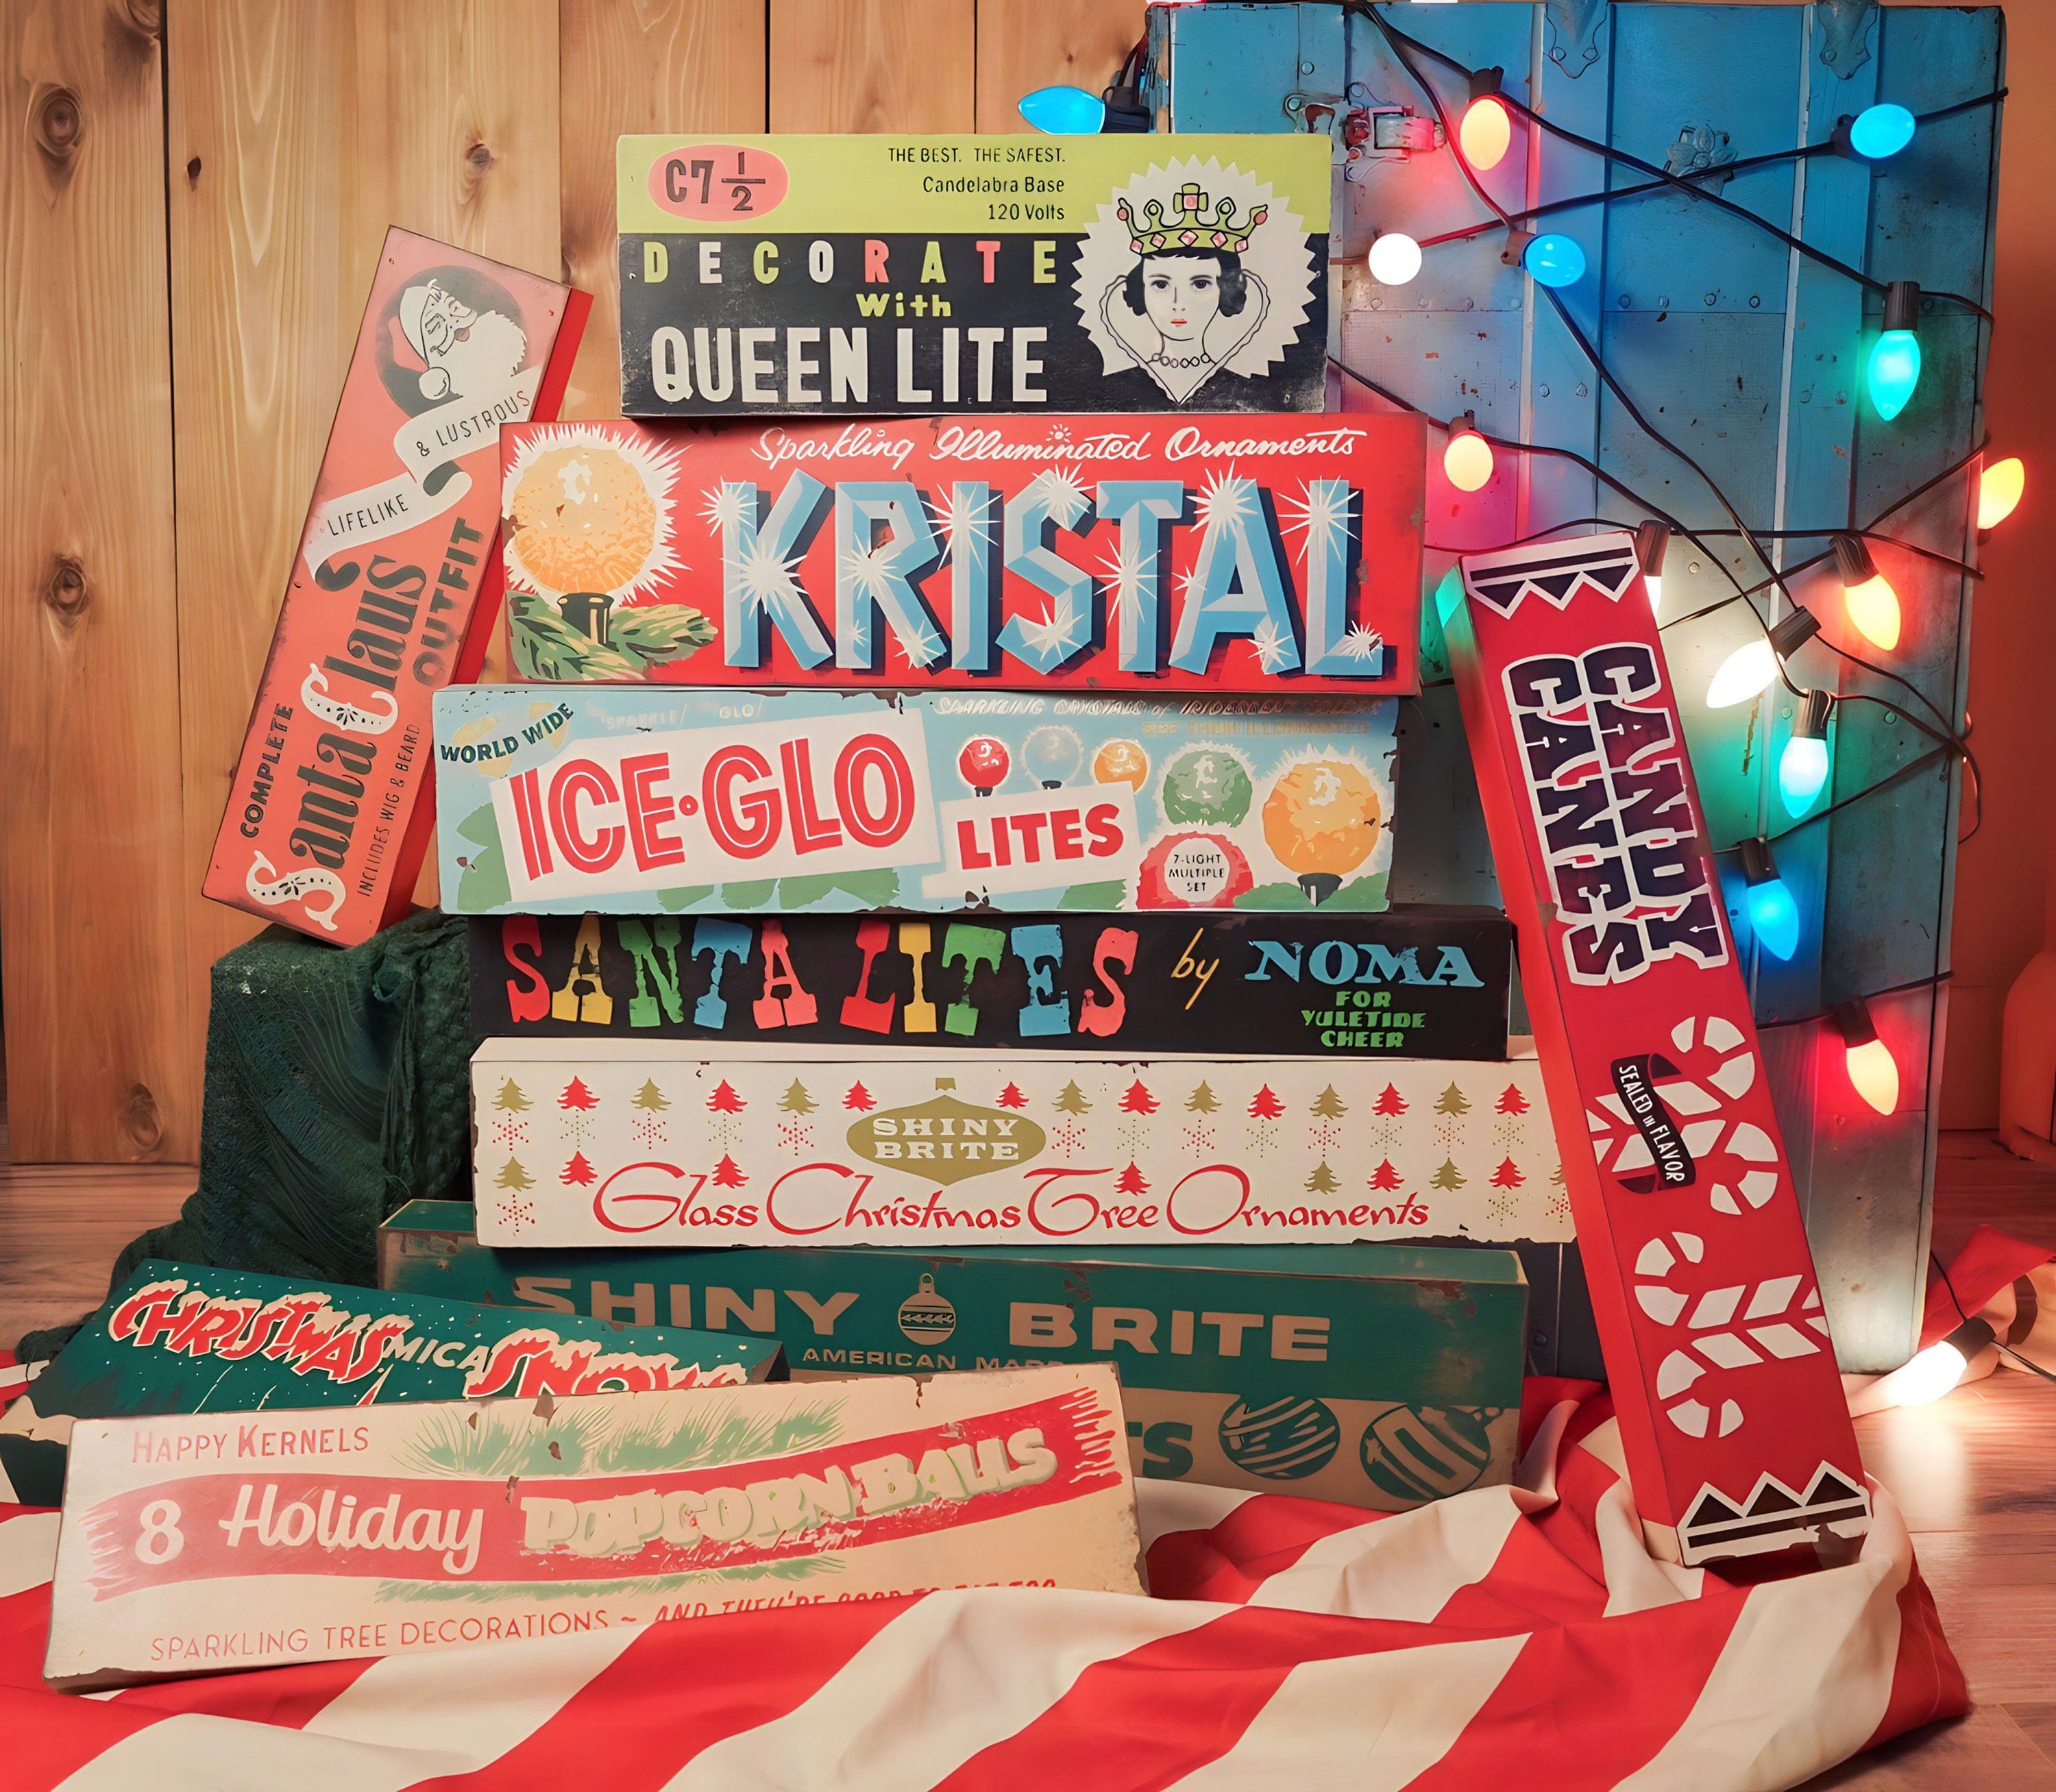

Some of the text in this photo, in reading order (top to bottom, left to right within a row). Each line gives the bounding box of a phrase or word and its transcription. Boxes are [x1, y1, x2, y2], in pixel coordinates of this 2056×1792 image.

[888, 147, 1066, 162] THE BEST. THE SAFEST.
[665, 159, 714, 204] C7
[922, 175, 1064, 193] Candelabra Base
[988, 204, 1065, 220] 120 Volts
[643, 241, 1057, 284] DECORATE
[855, 293, 951, 318] With
[650, 326, 1048, 403] QUEEN LITE
[415, 390, 530, 457] & LUSTROUS
[751, 424, 1367, 470] Sparkling Illuminated Ornaments
[326, 493, 409, 537] LIFELIKE
[721, 467, 1387, 677] KRISTAL
[413, 517, 484, 686] OUTFIT
[245, 553, 428, 932] Santa Claus
[440, 702, 574, 763] WORLD WIDE
[239, 702, 293, 838] COMPLETE
[356, 724, 420, 897] INCLUDES WIG & BEARD
[1501, 654, 1651, 986] CANES
[1578, 641, 1729, 970] CANDY
[957, 802, 1126, 870] LITES
[1168, 868, 1225, 878] MULTIPLE
[1186, 881, 1207, 892] SET
[502, 912, 1486, 1038] SANTA LITES by NOMA
[1335, 990, 1392, 1008] FOR
[1301, 1009, 1427, 1029] YULETIDE
[1320, 1029, 1405, 1048] CHEER
[872, 1118, 1019, 1138] SHINY
[1619, 1064, 1654, 1114] SEALED
[1649, 1124, 1685, 1182] FLAVOR
[872, 1141, 1021, 1161] BRITE
[592, 1161, 1430, 1236] Glass Christmas Tree Ornaments
[108, 1279, 415, 1384] CHRISTMAS
[382, 1334, 492, 1373] MICA
[511, 1275, 1331, 1364] SHINY BRITE
[802, 1347, 957, 1370] AMERICAN
[132, 1423, 370, 1464] HAPPY KERNELS
[134, 1427, 1059, 1575] 8 Holiday POPCORN BALLS
[150, 1627, 309, 1661] SPARKLING
[322, 1623, 387, 1650] TREE
[399, 1608, 609, 1646] DECORATIONS
